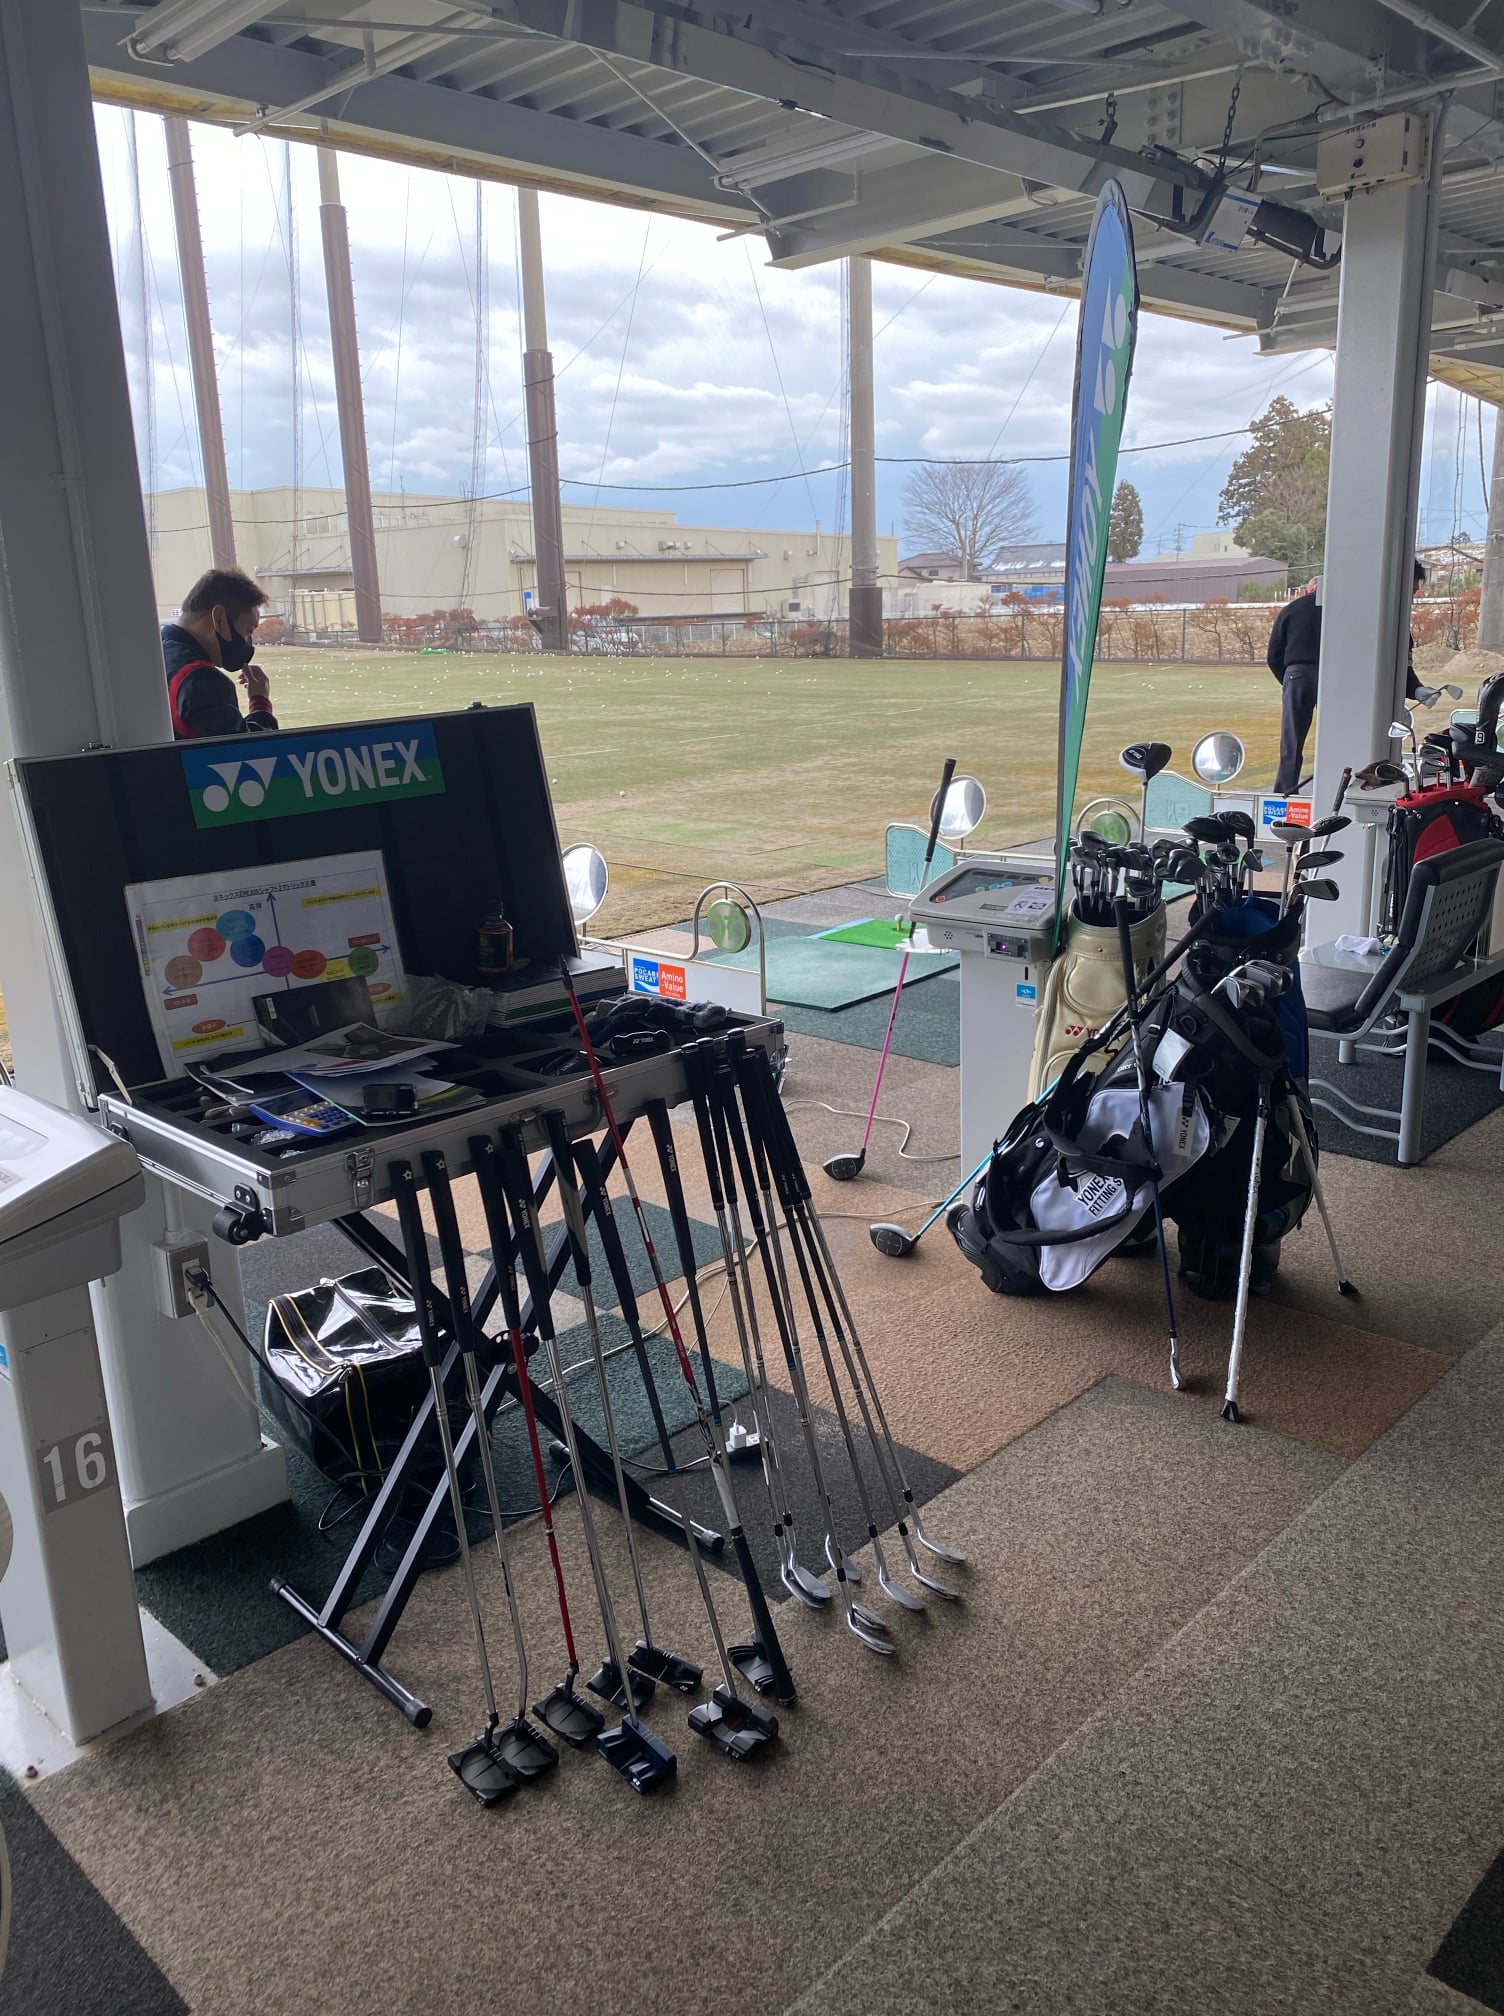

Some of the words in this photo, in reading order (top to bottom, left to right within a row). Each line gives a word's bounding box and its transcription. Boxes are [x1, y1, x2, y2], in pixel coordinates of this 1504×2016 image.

[287, 739, 427, 798] YONEX
[634, 967, 659, 979] POCARI
[634, 973, 657, 983] SWEAT
[661, 970, 684, 984] Amino
[1179, 1129, 1189, 1150] YONEX
[1088, 1183, 1117, 1216] FITTING
[521, 1208, 531, 1230] YONEX
[43, 1432, 107, 1502] 16
